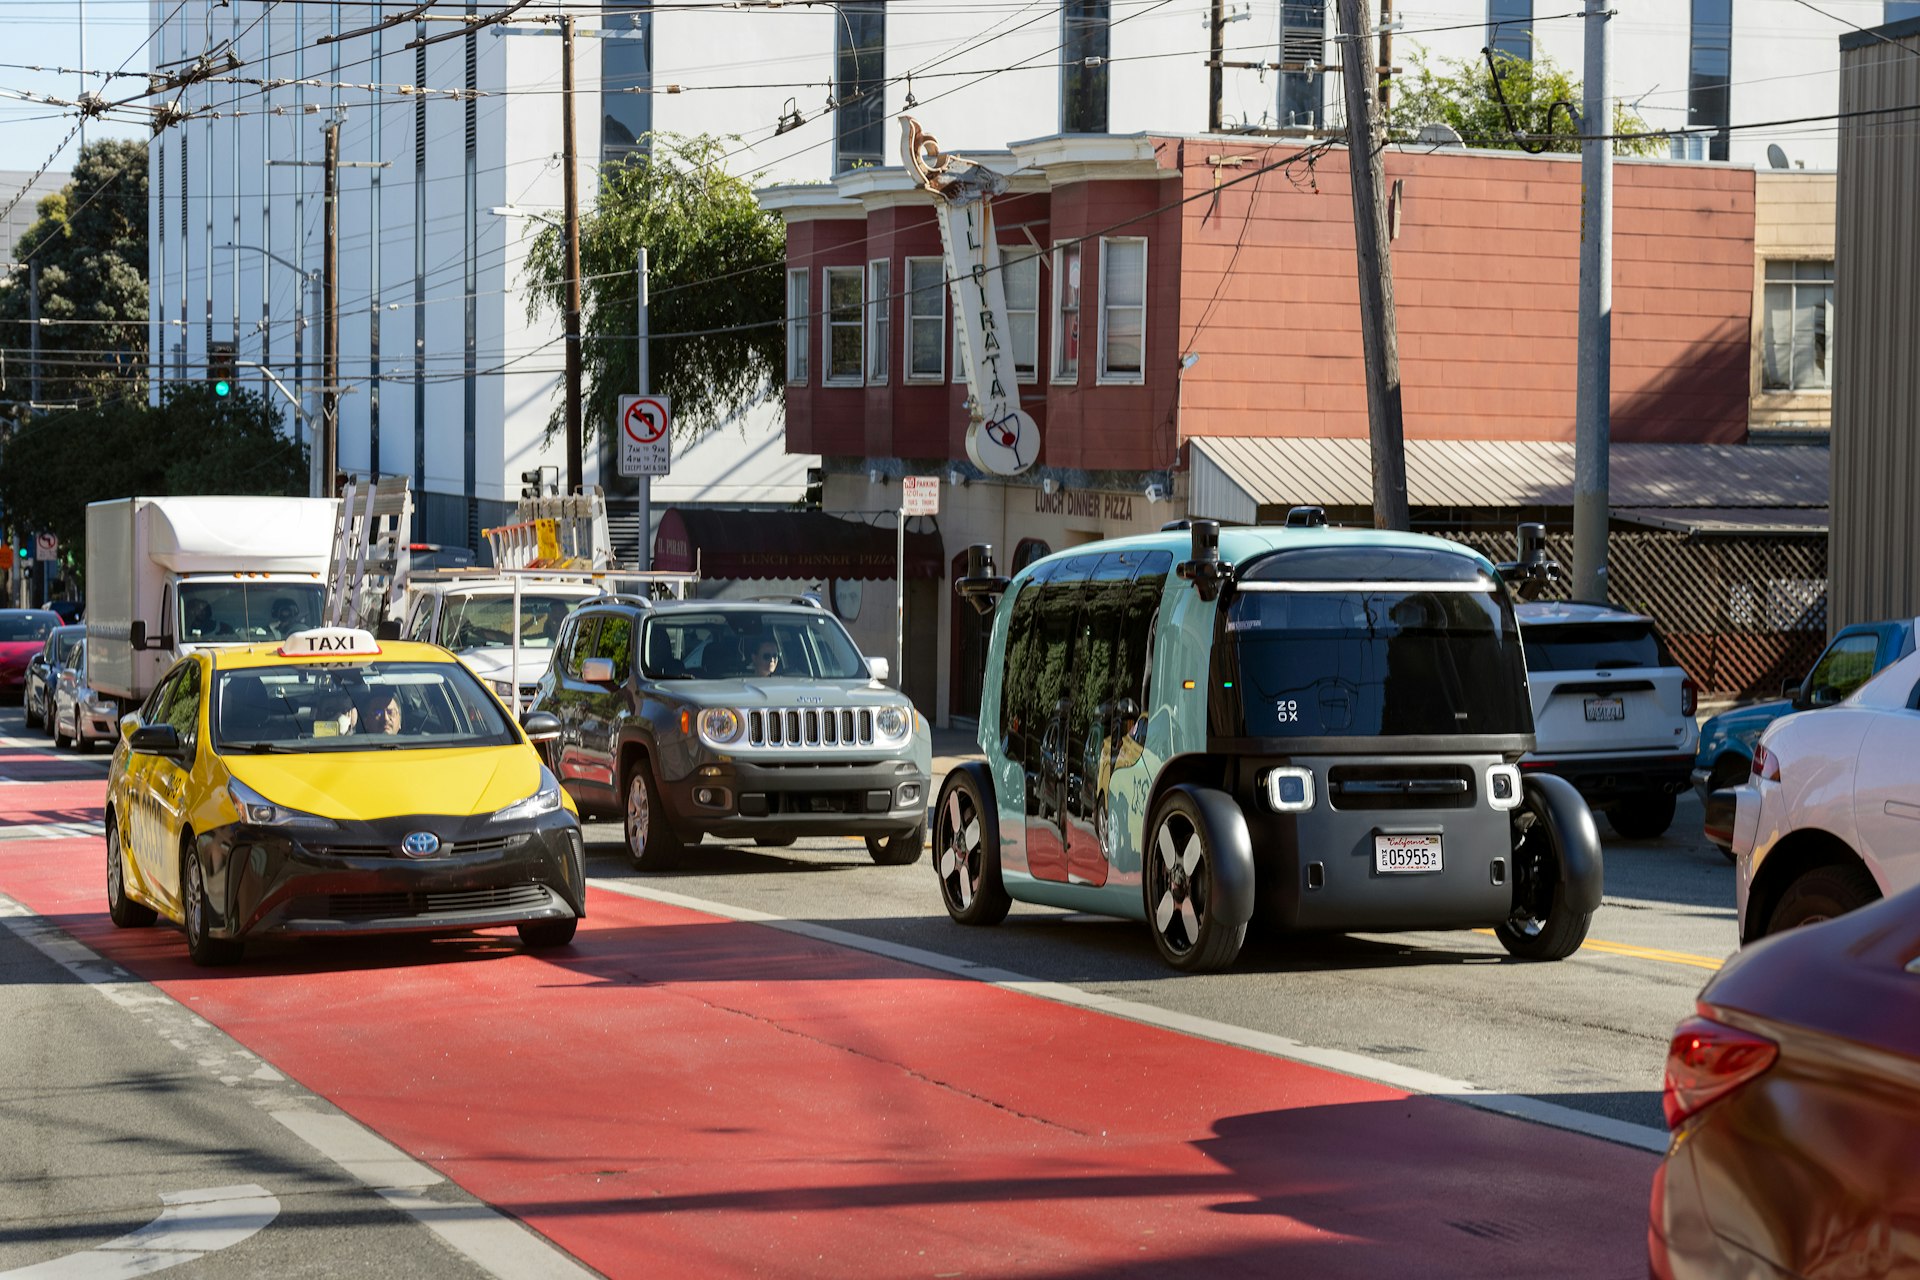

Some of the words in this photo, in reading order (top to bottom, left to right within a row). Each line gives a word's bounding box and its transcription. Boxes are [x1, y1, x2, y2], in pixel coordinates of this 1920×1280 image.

[966, 208, 981, 250] IL
[972, 264, 1007, 400] PIRATA
[627, 444, 640, 453] 7AM
[652, 445, 665, 453] 9AM
[916, 480, 937, 488] PARKING
[1035, 490, 1063, 514] LUNCH
[1067, 491, 1100, 518] DINNER
[1104, 494, 1133, 521] PIZZA
[658, 538, 665, 553] IL
[666, 539, 688, 557] PIRATA
[743, 554, 788, 565] LUNCH
[800, 554, 849, 565] DINNER
[859, 554, 897, 565] PIZZA
[305, 636, 354, 651] TAXI
[1389, 837, 1427, 848] California
[1389, 848, 1430, 866] 05955
